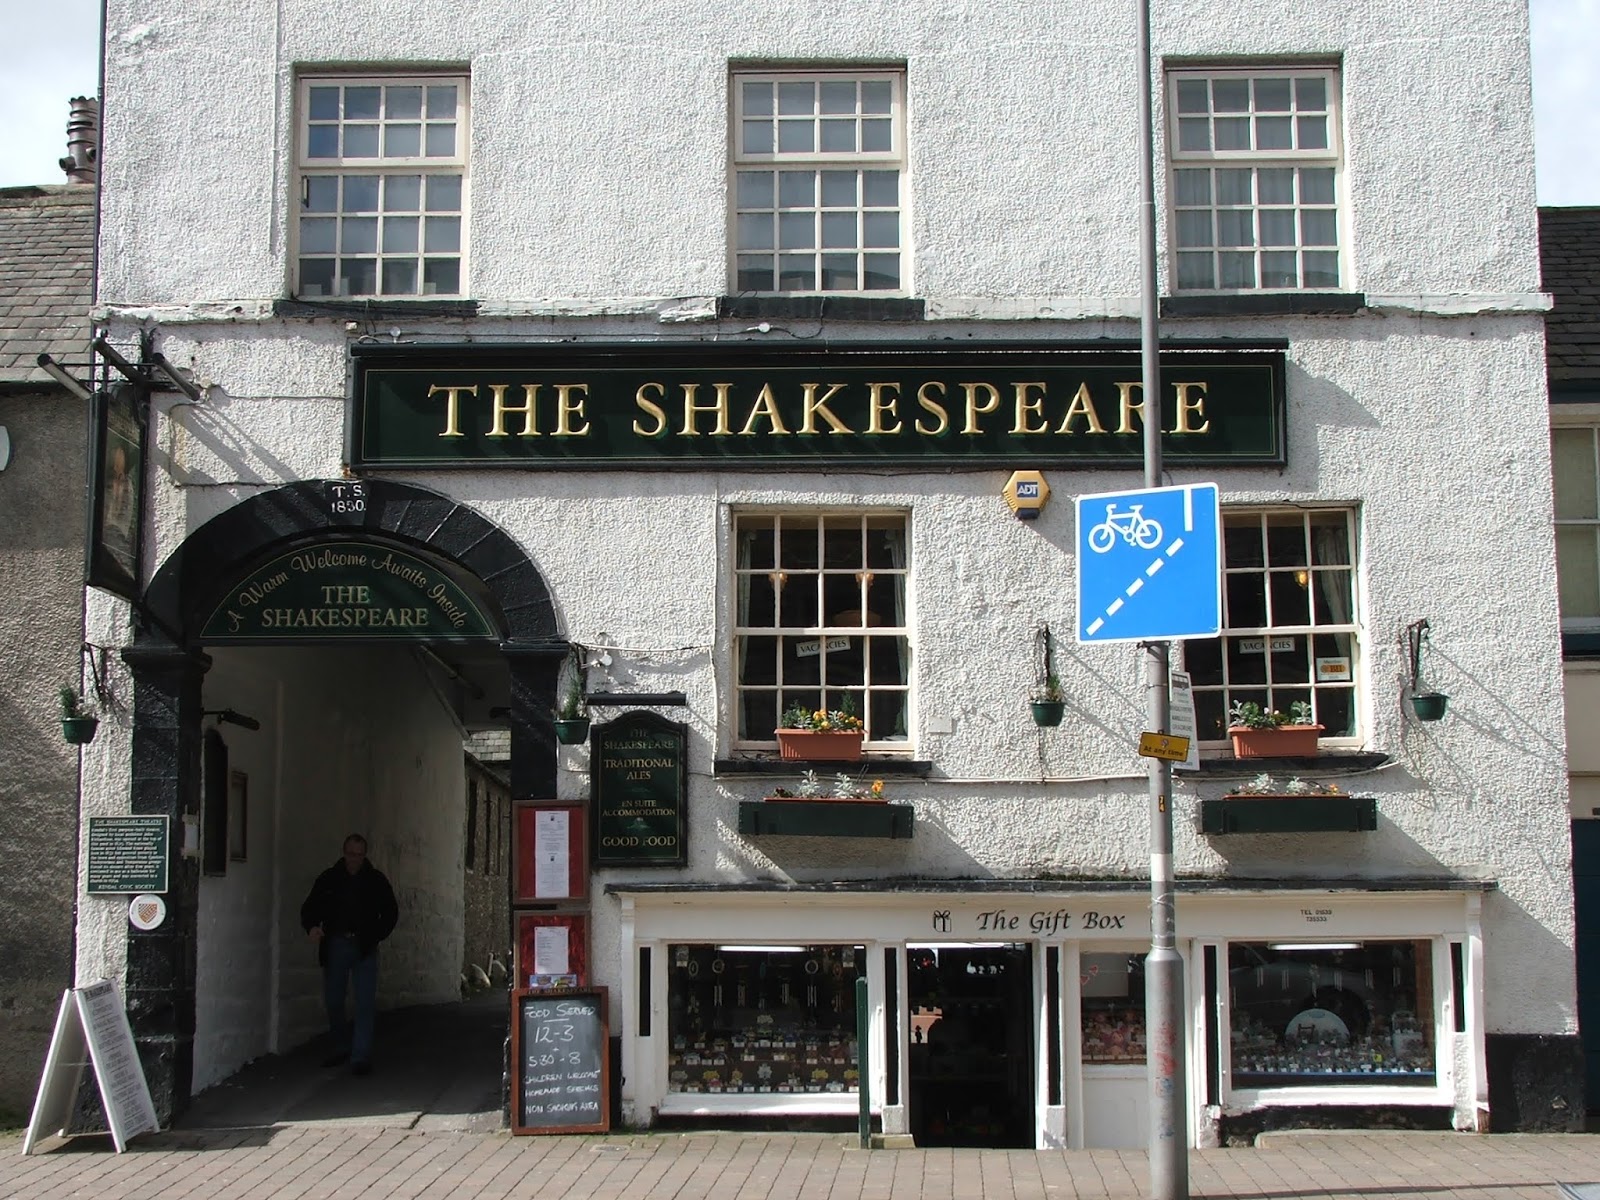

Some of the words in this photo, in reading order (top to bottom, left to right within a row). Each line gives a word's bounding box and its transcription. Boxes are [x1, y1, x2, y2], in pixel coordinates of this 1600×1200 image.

[428, 383, 590, 437] THE
[632, 381, 1210, 437] SHAKESPEARE
[1017, 484, 1038, 495] ADT
[227, 609, 244, 633] A
[239, 570, 290, 607] Warm
[291, 550, 367, 573] Welcome
[371, 553, 427, 589] Awaits
[427, 583, 468, 630] Inside
[321, 585, 370, 604] THE
[261, 608, 429, 628] SHAKESPEARE
[800, 639, 847, 653] VACCIES
[1243, 640, 1291, 650] VACCIES
[604, 740, 674, 750] SHAKESPEARE
[603, 758, 674, 769] TRADITIONAL
[626, 771, 651, 780] ALES
[621, 800, 632, 808] EN
[602, 808, 676, 817] ACCOMMODATION
[602, 836, 639, 847] GOOD
[642, 836, 676, 847] FOOD
[976, 909, 1020, 930] The
[1029, 908, 1072, 937] Gift
[1082, 911, 1126, 930] Box
[567, 1069, 601, 1080] WELCOME
[525, 1105, 544, 1115] NON
[580, 1101, 599, 1111] AREA
